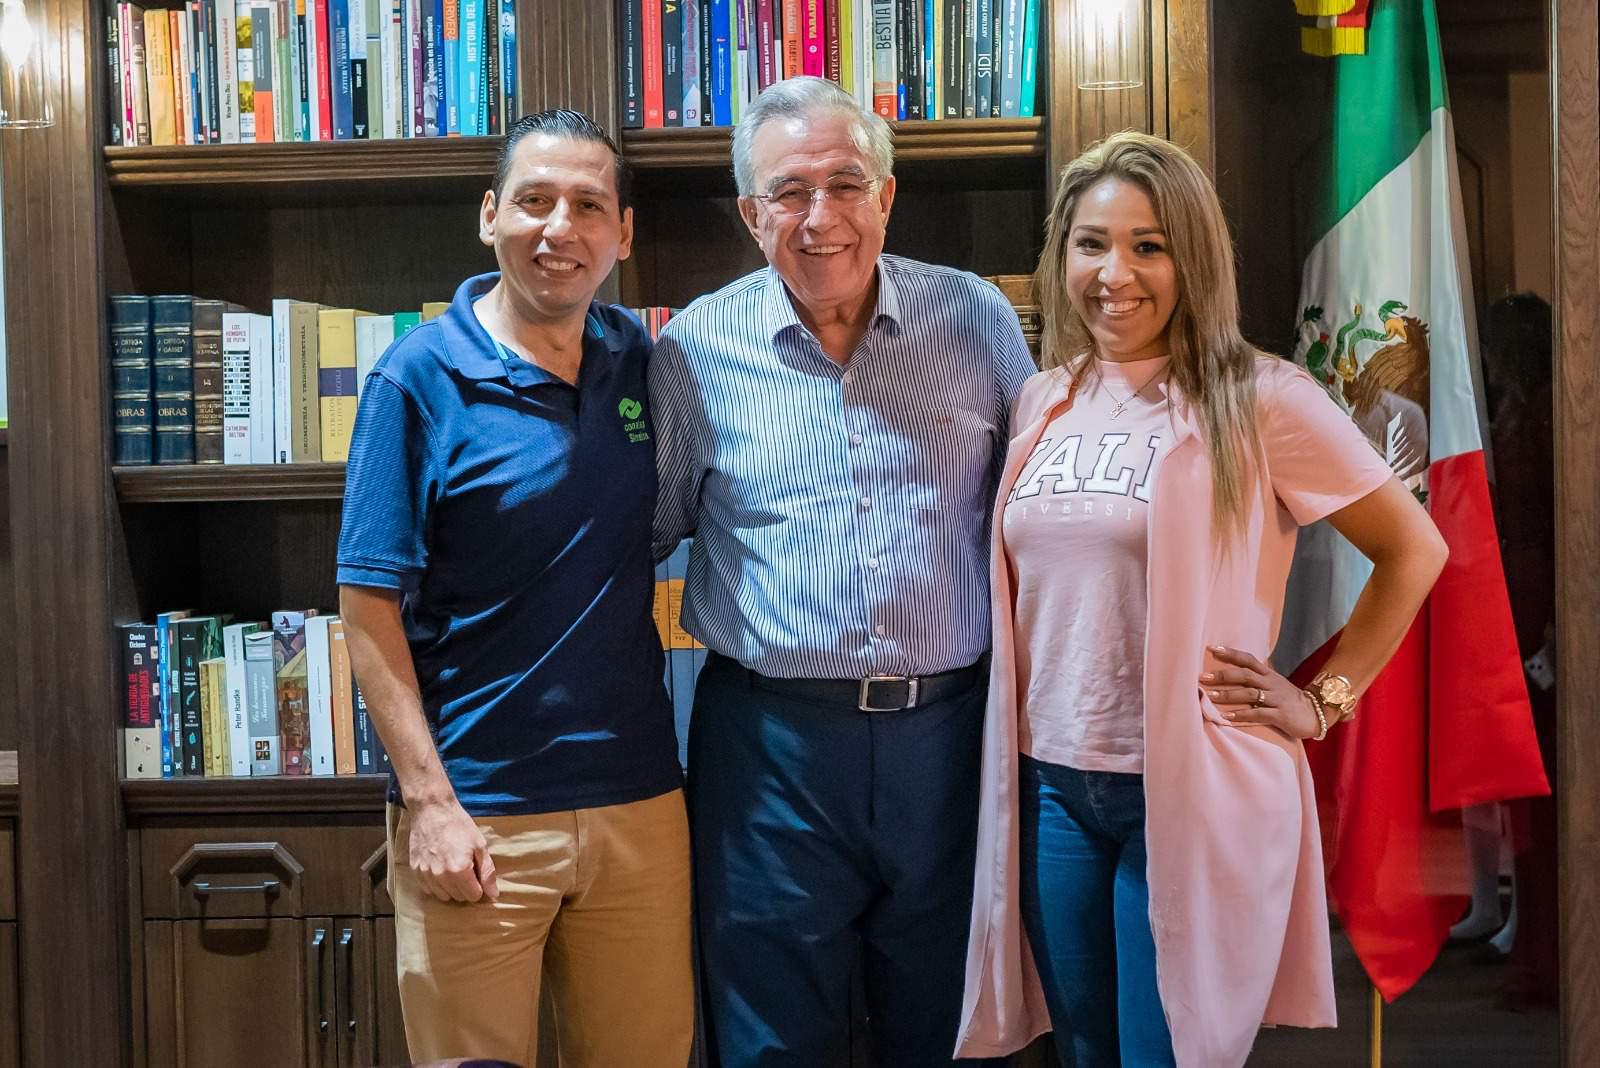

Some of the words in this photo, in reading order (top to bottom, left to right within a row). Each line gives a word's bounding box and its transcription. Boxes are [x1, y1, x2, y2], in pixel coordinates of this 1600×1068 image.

[446, 6, 456, 40] RIVERA
[466, 2, 476, 20] DEL
[466, 21, 476, 62] HISTORIA
[978, 54, 991, 77] SIDI
[129, 684, 138, 709] TIENDA
